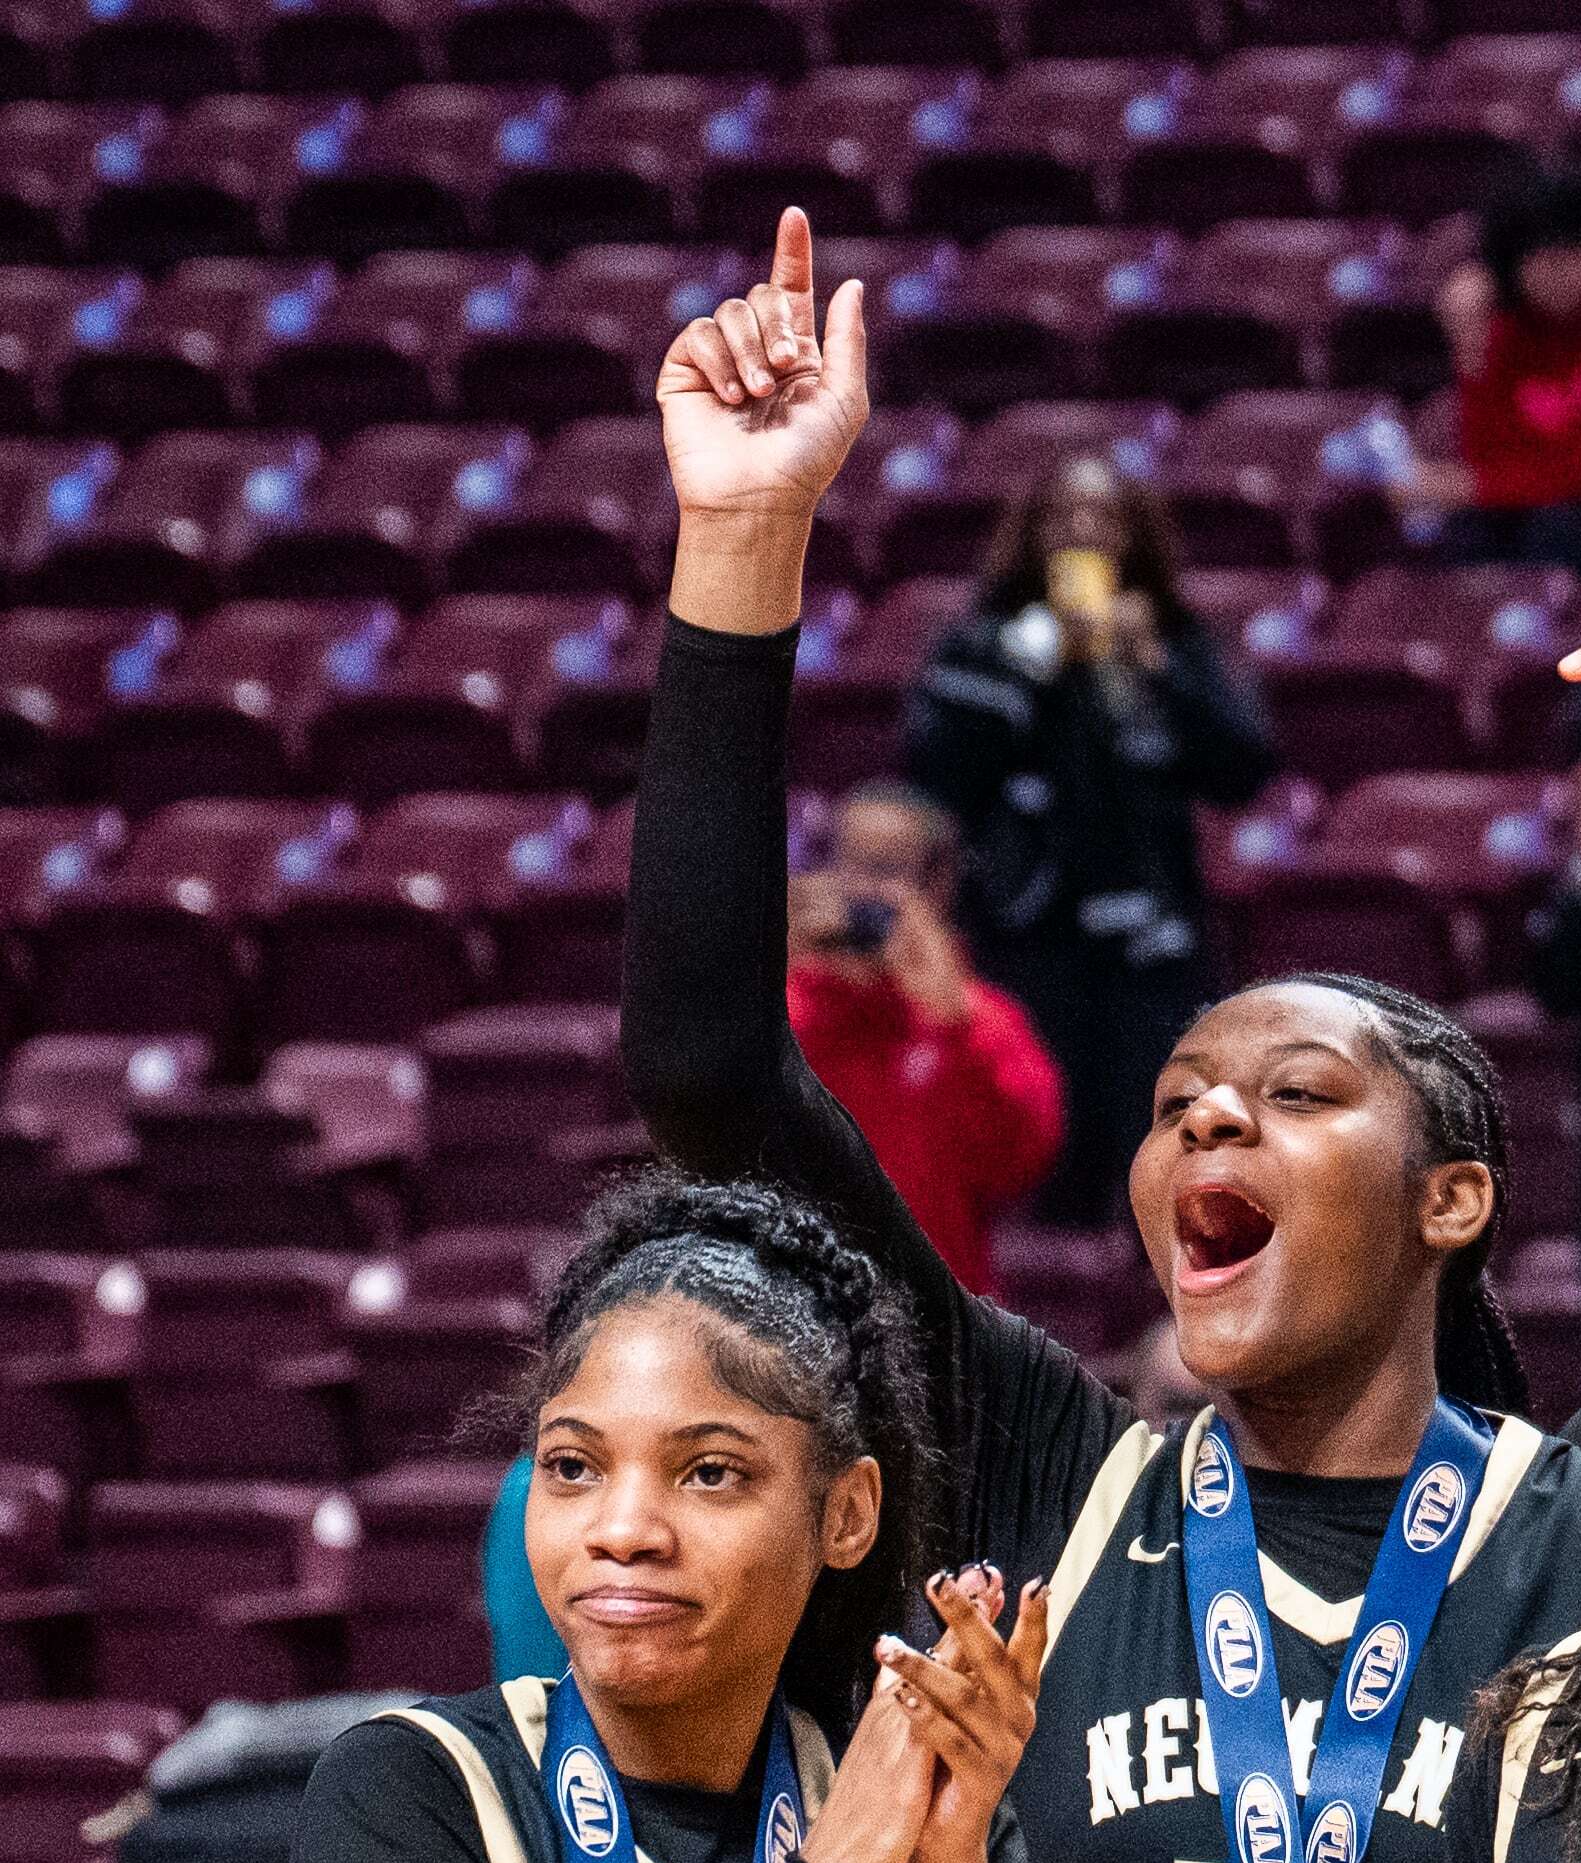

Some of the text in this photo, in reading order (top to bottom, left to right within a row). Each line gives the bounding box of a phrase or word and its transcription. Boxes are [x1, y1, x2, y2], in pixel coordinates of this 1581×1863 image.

[1409, 1466, 1460, 1545] PIAA
[1210, 1596, 1255, 1694] PIAA
[1351, 1626, 1404, 1716] PIAA
[563, 1751, 611, 1850] PIAA
